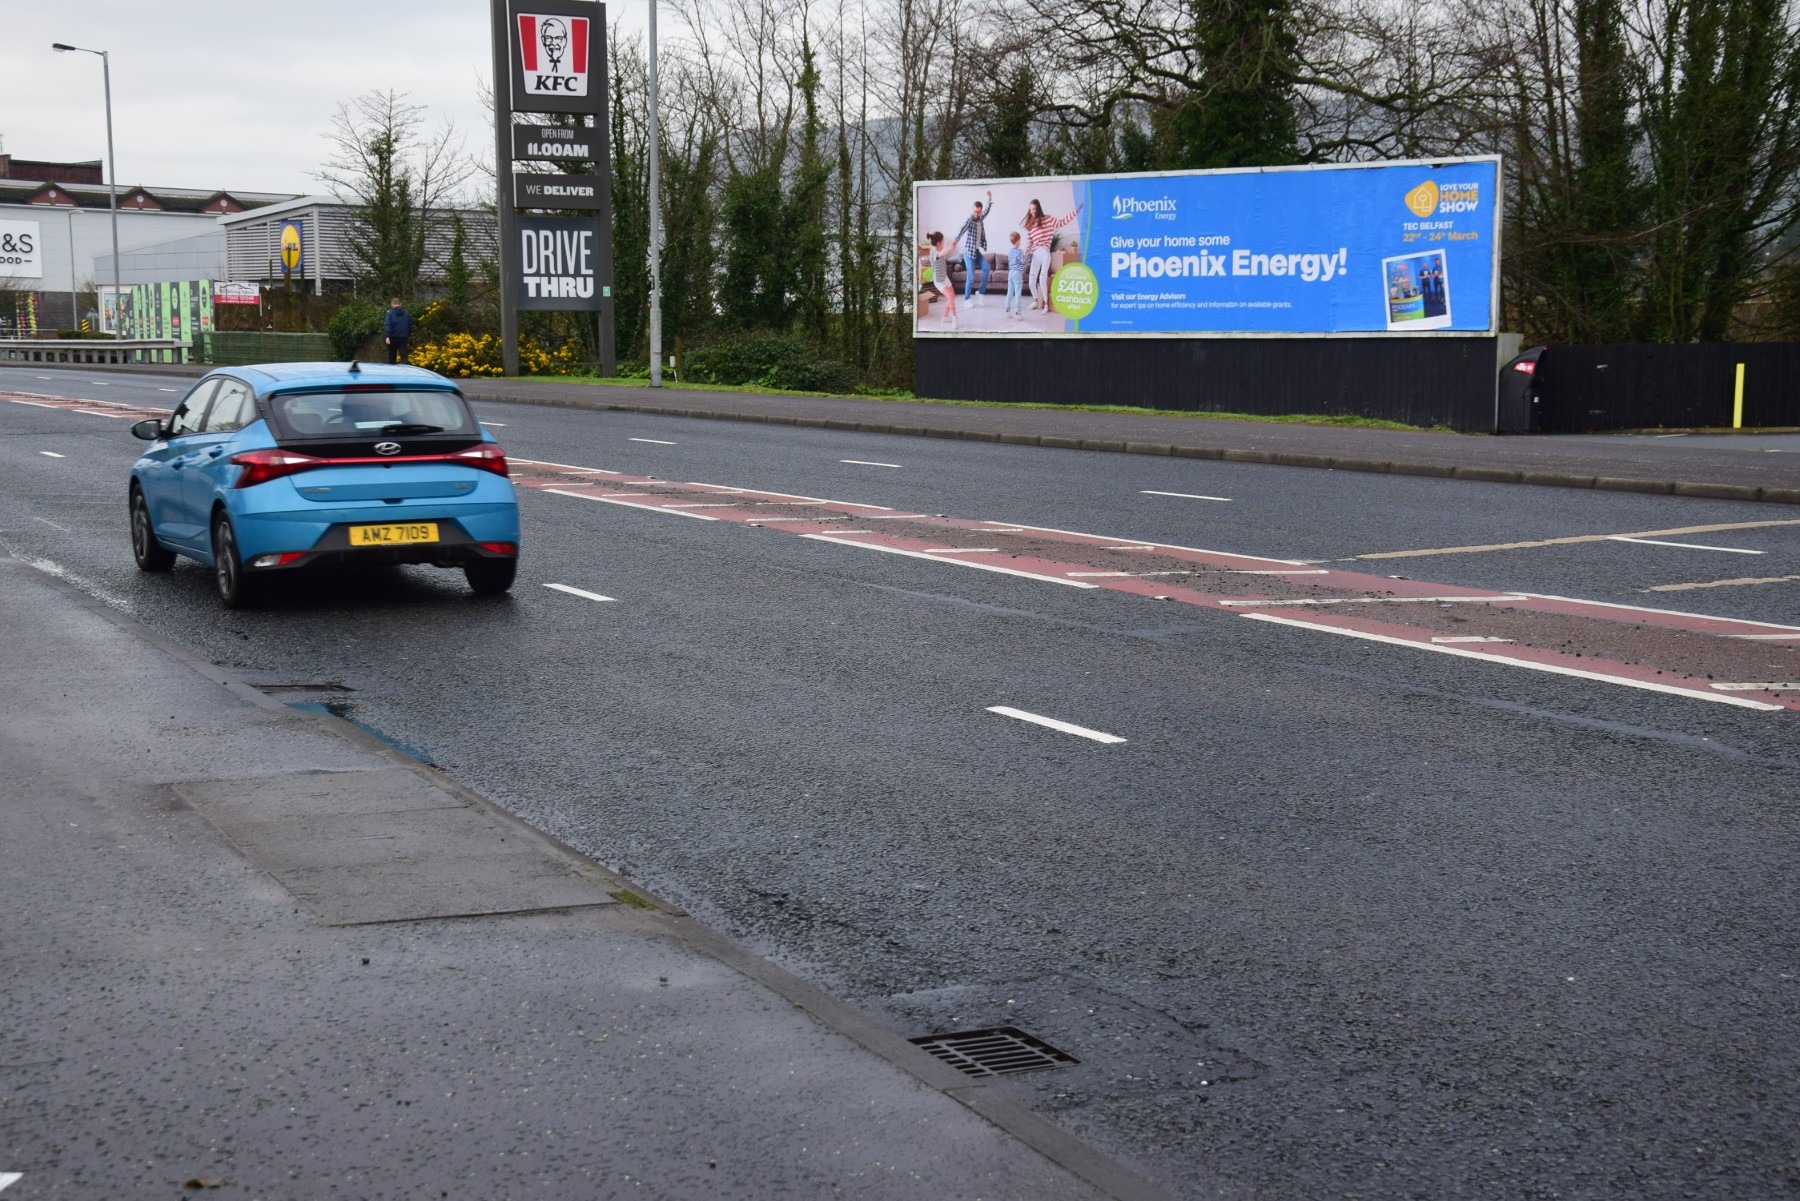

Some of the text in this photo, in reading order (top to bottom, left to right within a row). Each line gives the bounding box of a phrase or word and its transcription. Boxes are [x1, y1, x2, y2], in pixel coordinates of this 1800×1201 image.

[534, 75, 578, 92] KFC
[541, 128, 574, 139] OPEN FROM
[527, 142, 589, 157] 11.00AM
[526, 184, 594, 197] WE DELIVER
[1440, 182, 1479, 191] LOVE YOUR
[1440, 189, 1478, 202] HOME
[1122, 195, 1177, 212] Phoenix
[1439, 201, 1478, 213] SHOW
[1155, 212, 1177, 220] Energy
[1403, 221, 1454, 231] TEC BELFAST
[1448, 231, 1479, 240] March
[1, 233, 34, 254] &S
[1110, 235, 1230, 250] Give your home some
[521, 229, 594, 275] DRIVE
[0, 256, 22, 264] OOD
[1111, 247, 1348, 282] Phoenix Energy!
[523, 276, 594, 299] THRU
[1057, 279, 1093, 295] £400
[1056, 294, 1092, 304] cashback
[1137, 293, 1159, 301] Energy
[1159, 292, 1186, 300] Advisors
[362, 525, 430, 542] AMZ 7109
